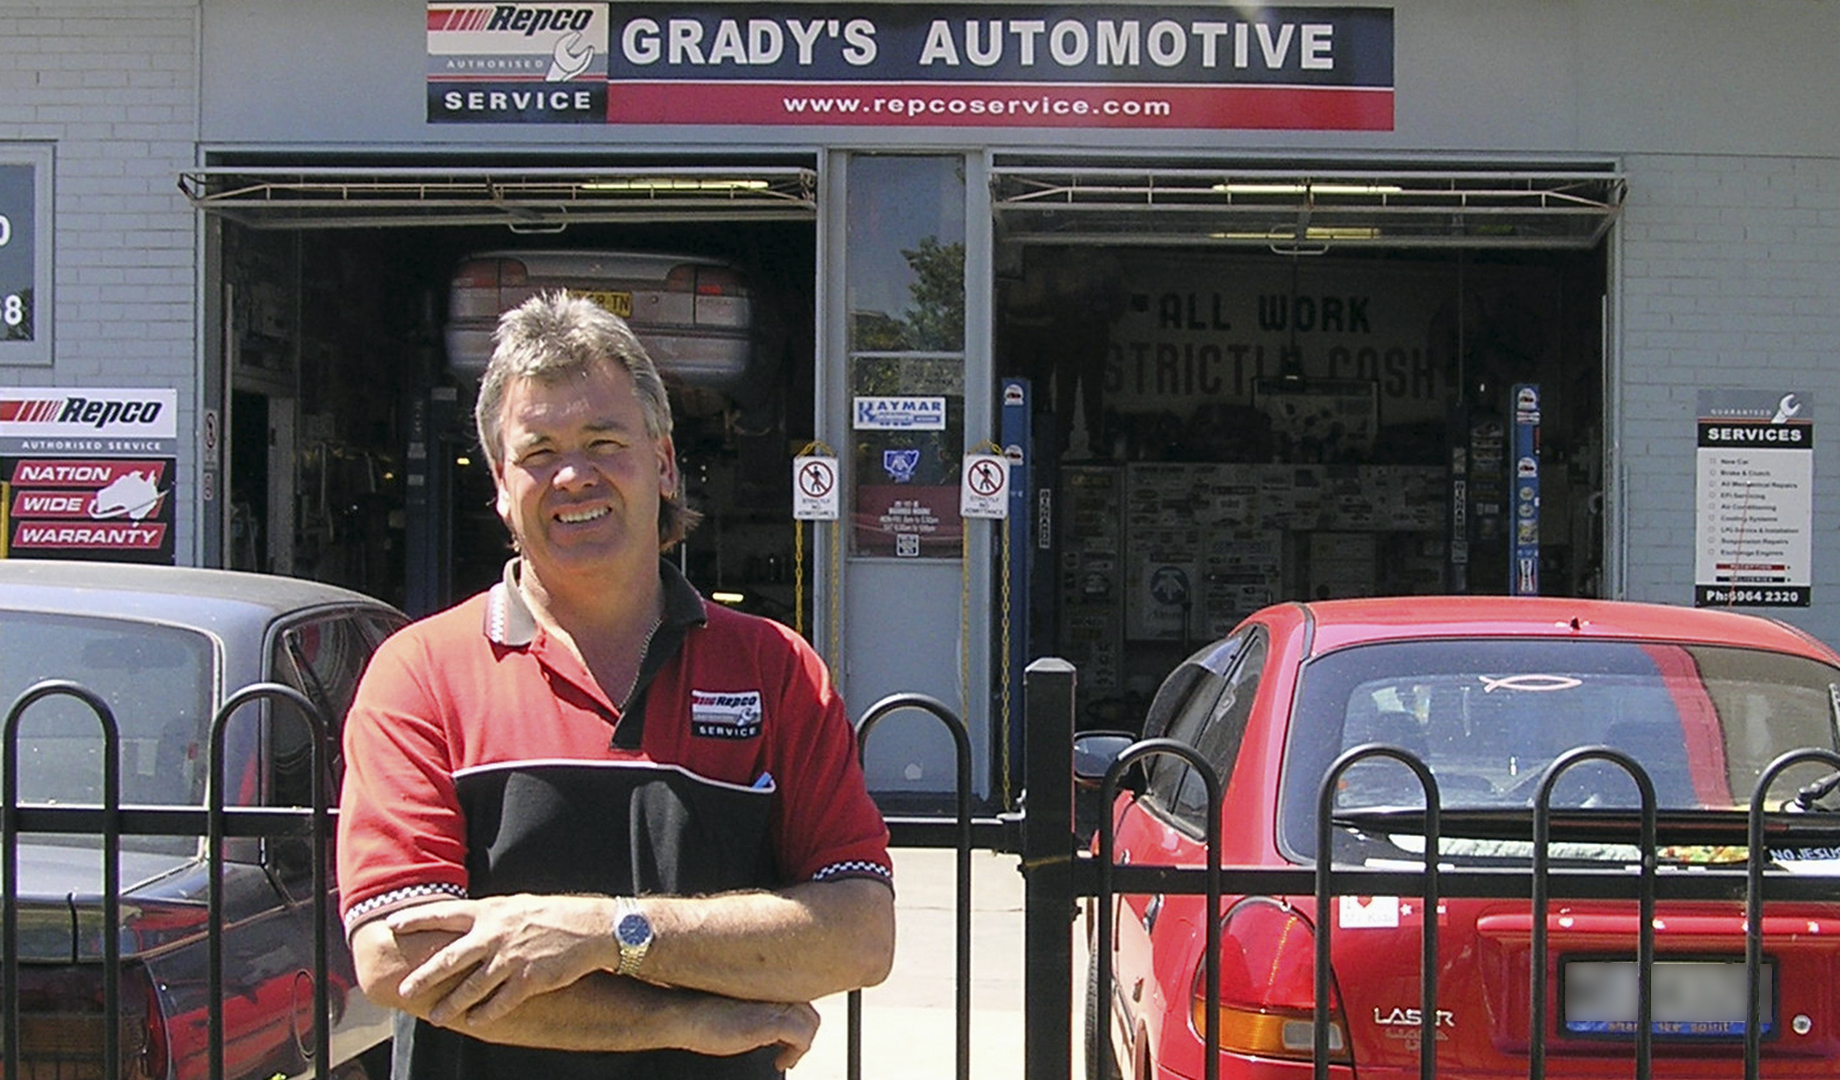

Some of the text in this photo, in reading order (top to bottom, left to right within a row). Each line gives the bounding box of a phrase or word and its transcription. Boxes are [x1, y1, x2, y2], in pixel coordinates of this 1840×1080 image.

[487, 4, 595, 36] Repco
[621, 18, 1335, 70] GRADY'S AUTOMOTIVE
[446, 59, 544, 69] AUTHORISED
[444, 91, 592, 110] SERVICE
[783, 96, 1171, 117] www.repcoservice.com
[0, 294, 23, 326] 8
[1257, 293, 1371, 334] WORK
[58, 397, 162, 428] Repco
[858, 400, 941, 423] KAYMAR
[1710, 408, 1772, 416] GUARANTEED
[1707, 427, 1802, 442] SERVICES
[22, 440, 161, 451] AUTHORISED SERVICE
[20, 466, 111, 482] NATION
[22, 497, 83, 513] WIDE
[21, 528, 158, 544] WARRANTY
[1764, 591, 1799, 602] 2320
[716, 696, 757, 708] Repco
[700, 726, 757, 736] SERVICE
[1769, 848, 1795, 860] NO
[1373, 1007, 1455, 1026] LASR
